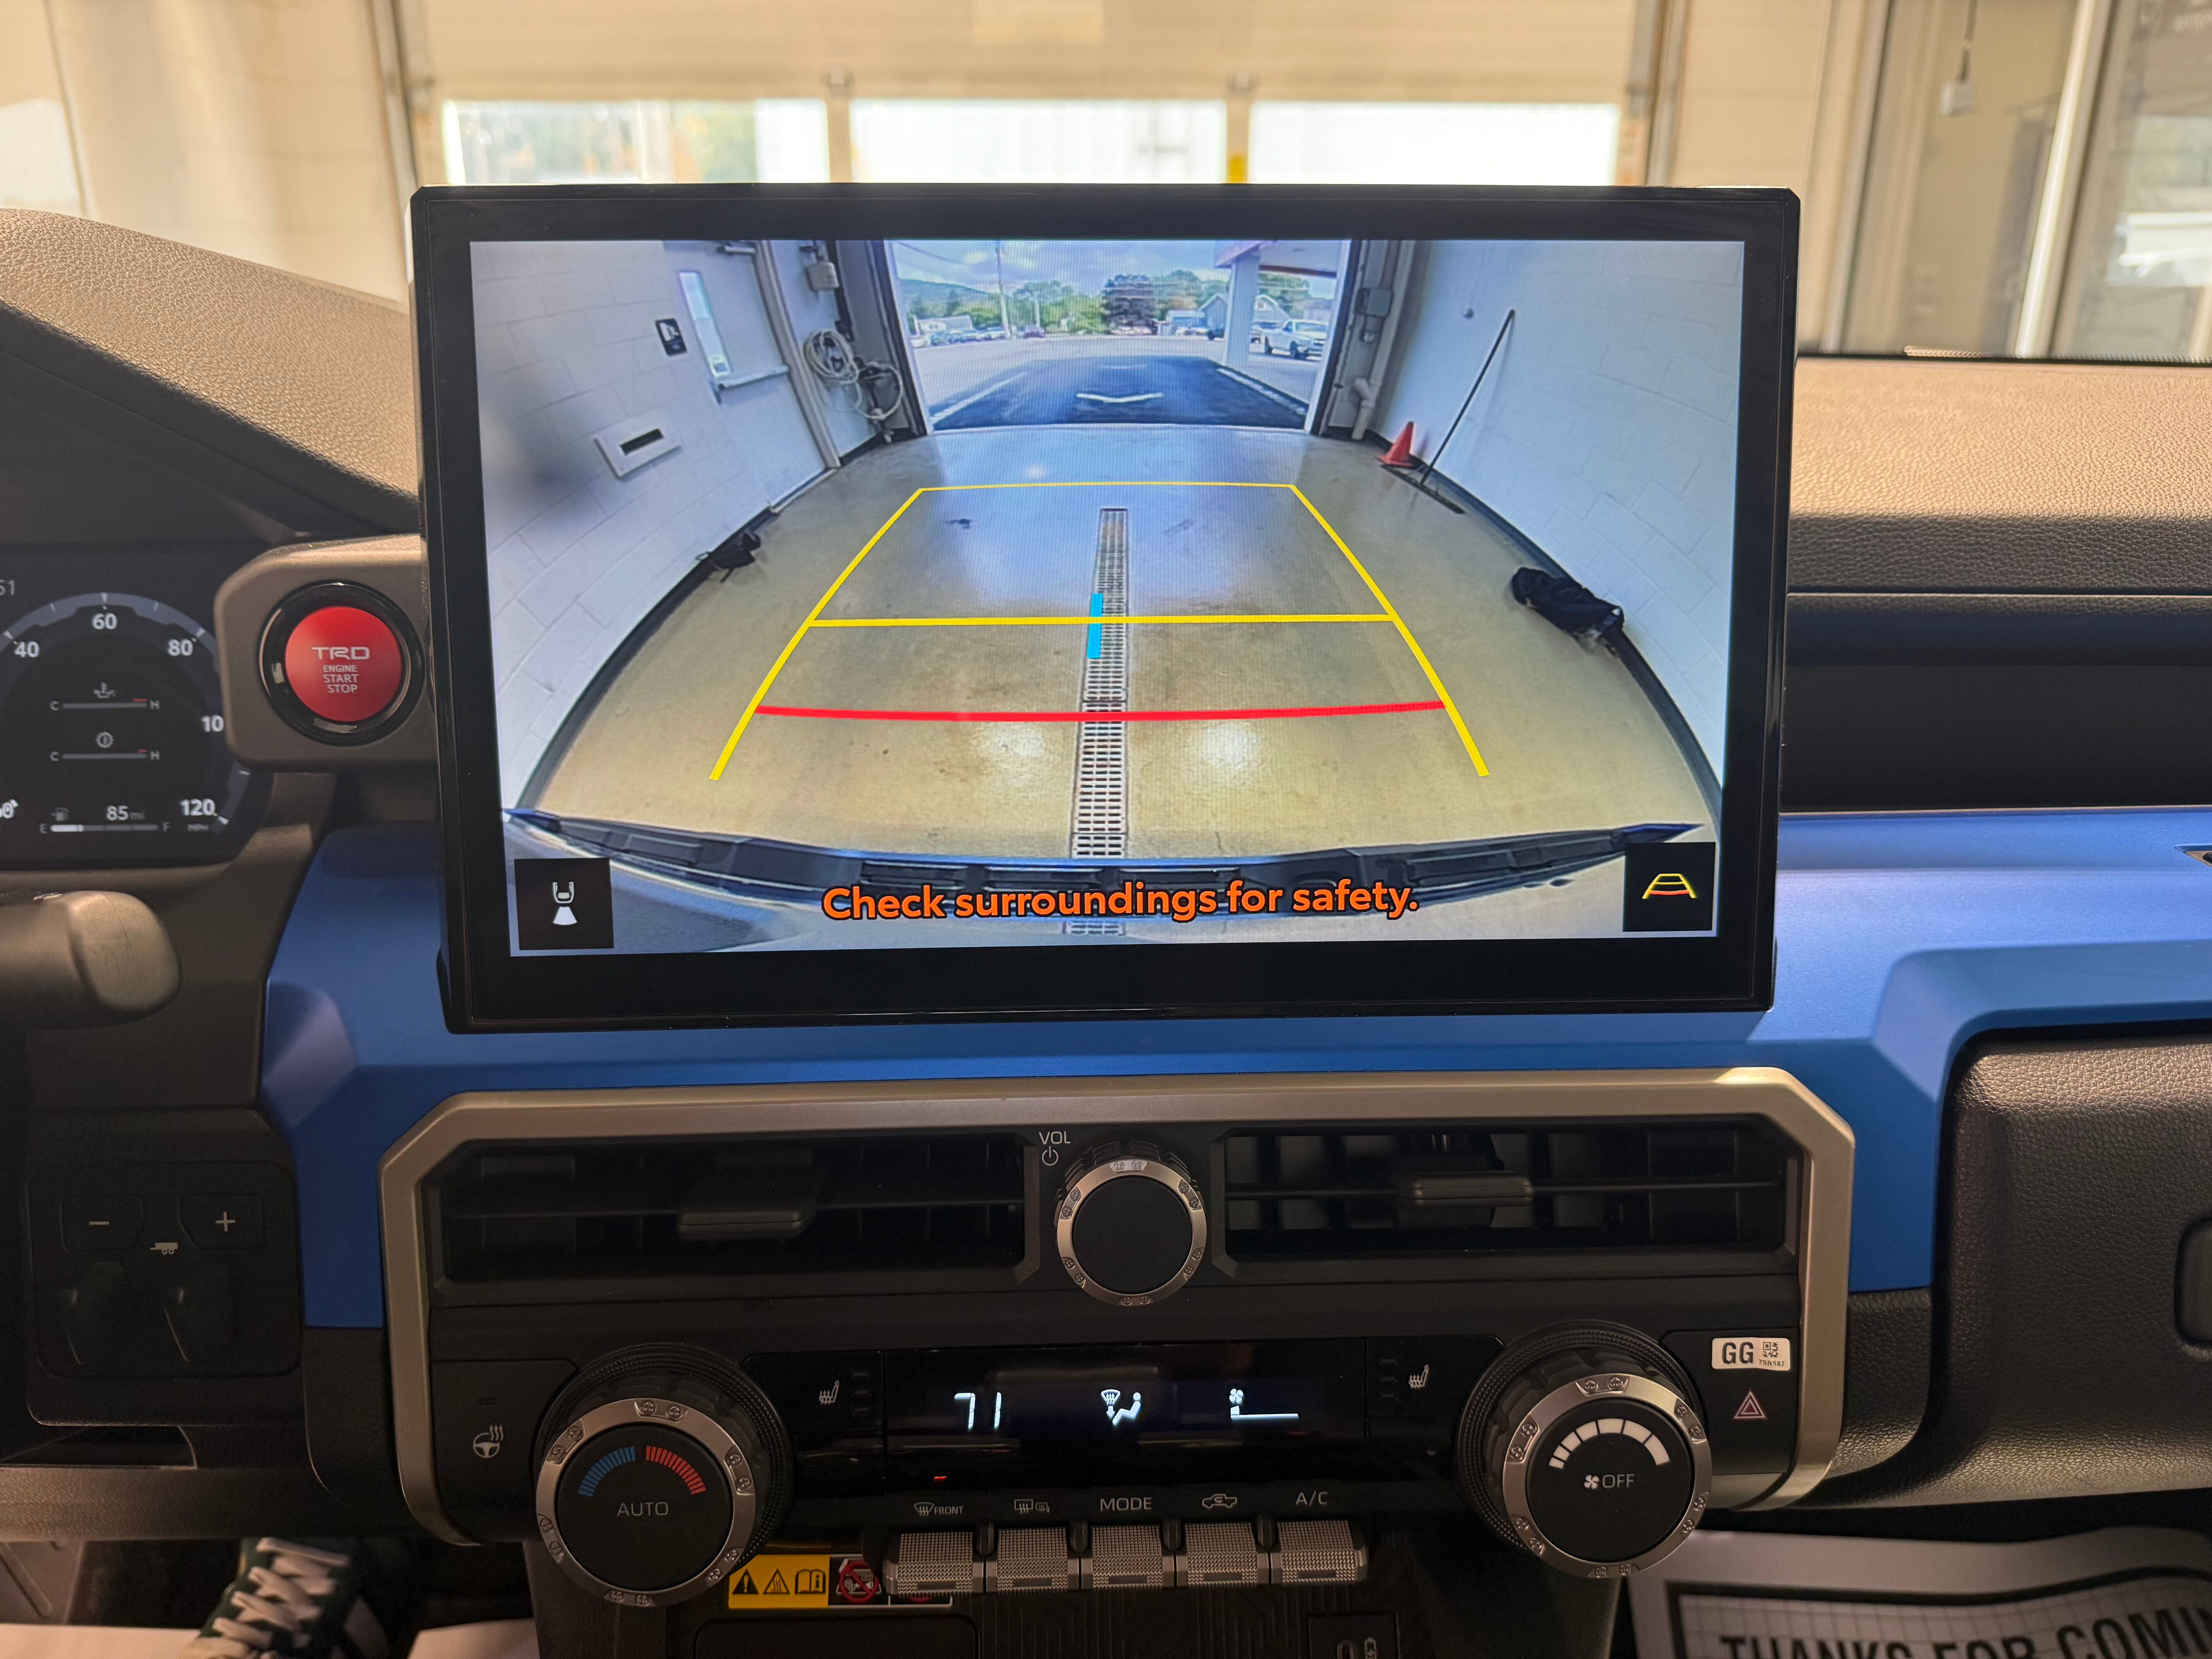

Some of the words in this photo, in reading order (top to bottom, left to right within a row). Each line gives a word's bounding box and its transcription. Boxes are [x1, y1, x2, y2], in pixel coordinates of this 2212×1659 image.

[92, 613, 117, 630] 60
[14, 641, 40, 658] 40
[167, 639, 193, 656] 80
[311, 646, 370, 660] TRD
[323, 674, 359, 683] START
[328, 684, 358, 693] STOP
[50, 701, 60, 711] C
[150, 700, 160, 709] H
[201, 714, 225, 732] 10
[50, 752, 60, 762] C
[150, 751, 160, 761] H
[106, 805, 129, 821] 85
[180, 798, 215, 816] 120
[40, 823, 48, 834] E
[823, 884, 947, 919] Check
[955, 882, 1218, 922] surroundings
[1226, 879, 1284, 913] for
[1293, 878, 1420, 919] safety.
[1039, 1131, 1071, 1144] VOL
[1722, 1341, 1754, 1364] GG
[954, 1391, 1002, 1431] 71
[1602, 1474, 1635, 1489] OFF
[1100, 1497, 1152, 1512] MODE
[1295, 1490, 1329, 1506] A/C
[617, 1501, 669, 1516] AUTO
[934, 1506, 964, 1515] FRONT
